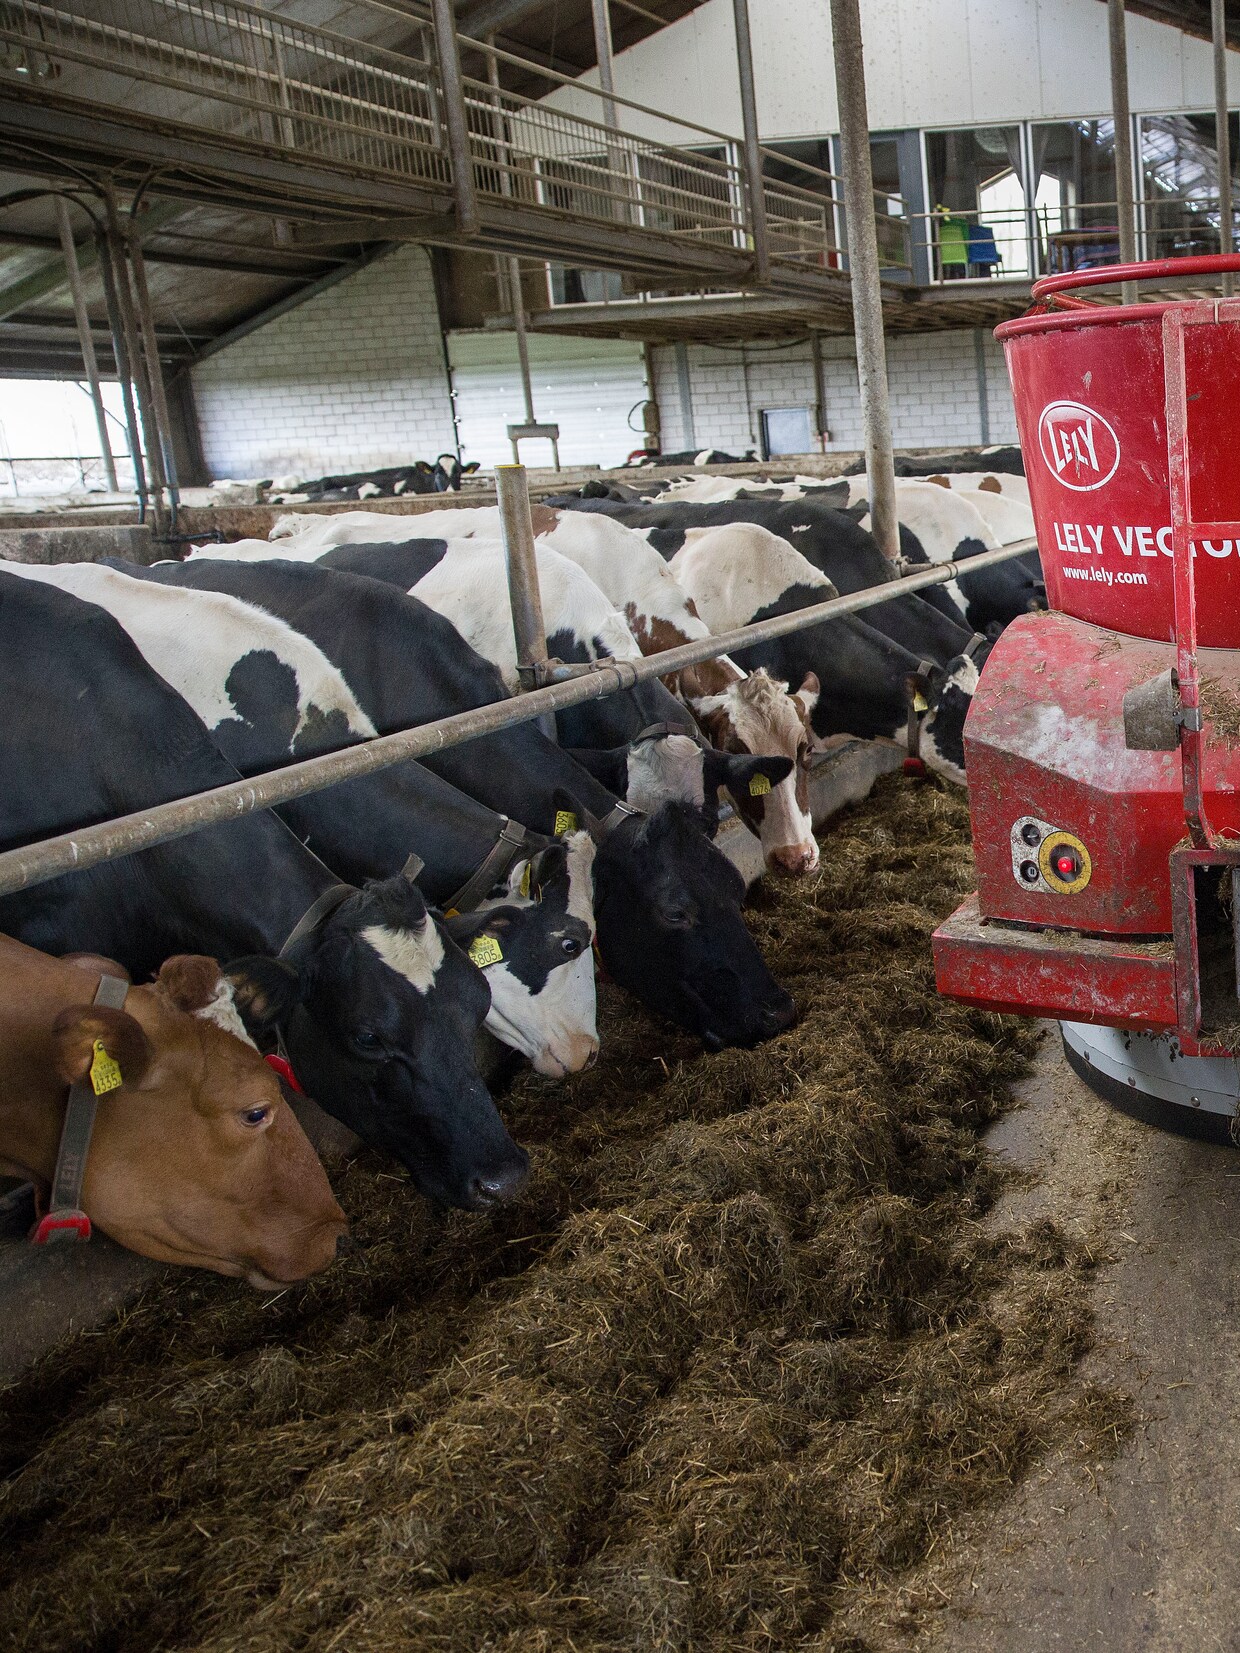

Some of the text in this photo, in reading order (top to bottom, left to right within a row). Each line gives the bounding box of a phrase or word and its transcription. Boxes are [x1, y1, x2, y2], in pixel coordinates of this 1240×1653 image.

[1047, 417, 1099, 474] LELY
[1053, 522, 1104, 555] LELY
[1062, 565, 1149, 587] www.lely.com
[470, 948, 497, 966] 3805
[96, 1072, 118, 1092] 4335
